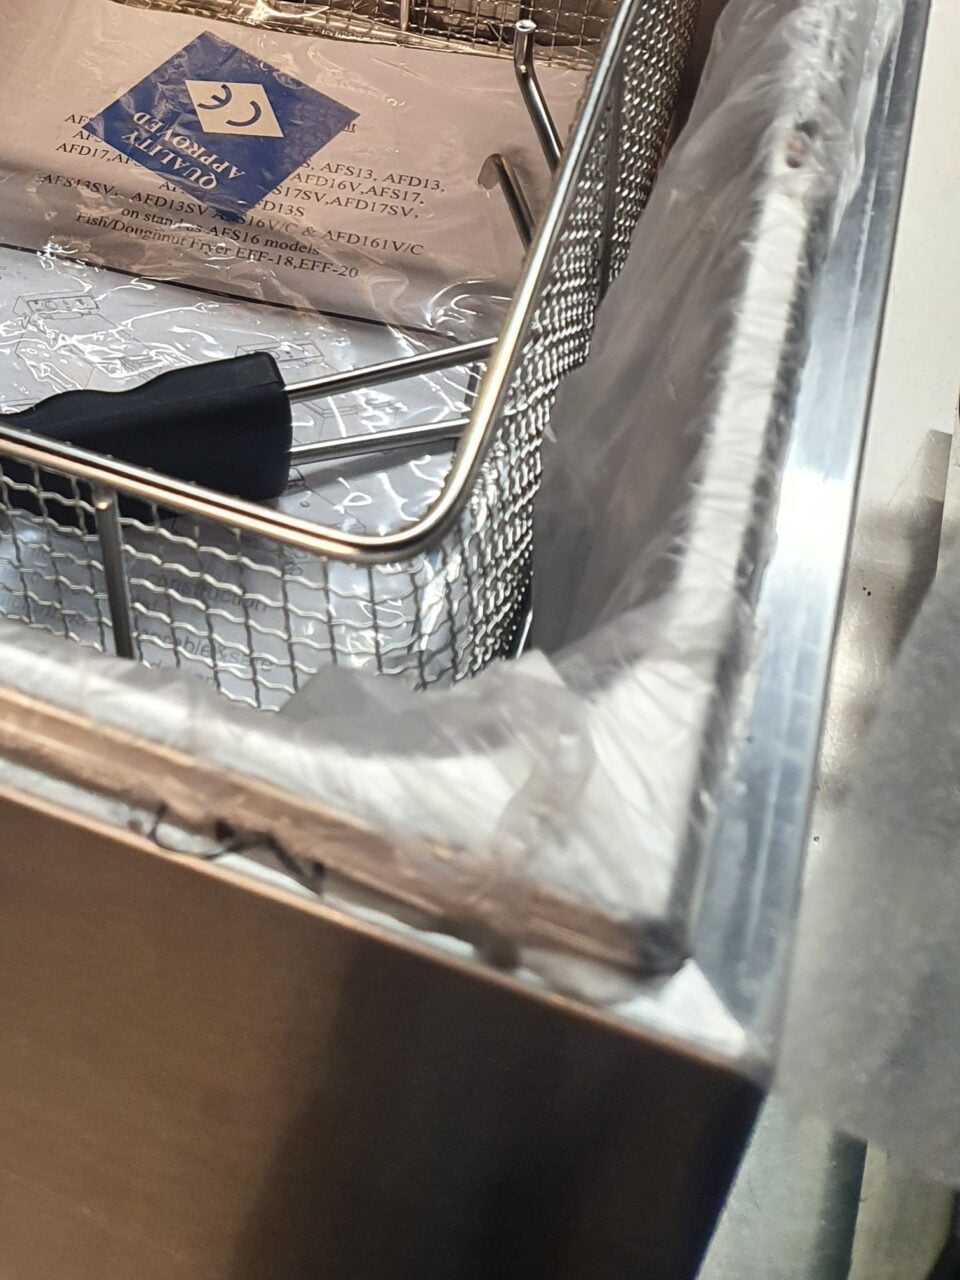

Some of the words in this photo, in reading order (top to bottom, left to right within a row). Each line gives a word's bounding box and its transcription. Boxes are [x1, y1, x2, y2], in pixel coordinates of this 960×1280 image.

[121, 130, 218, 190] QUALITY
[133, 111, 246, 180] APPROVED
[75, 213, 189, 248] Fish/Doughnut
[190, 238, 232, 257] Fryer
[121, 207, 140, 220] on
[207, 224, 260, 246] AFS16
[263, 237, 320, 257] models
[302, 225, 318, 238] &
